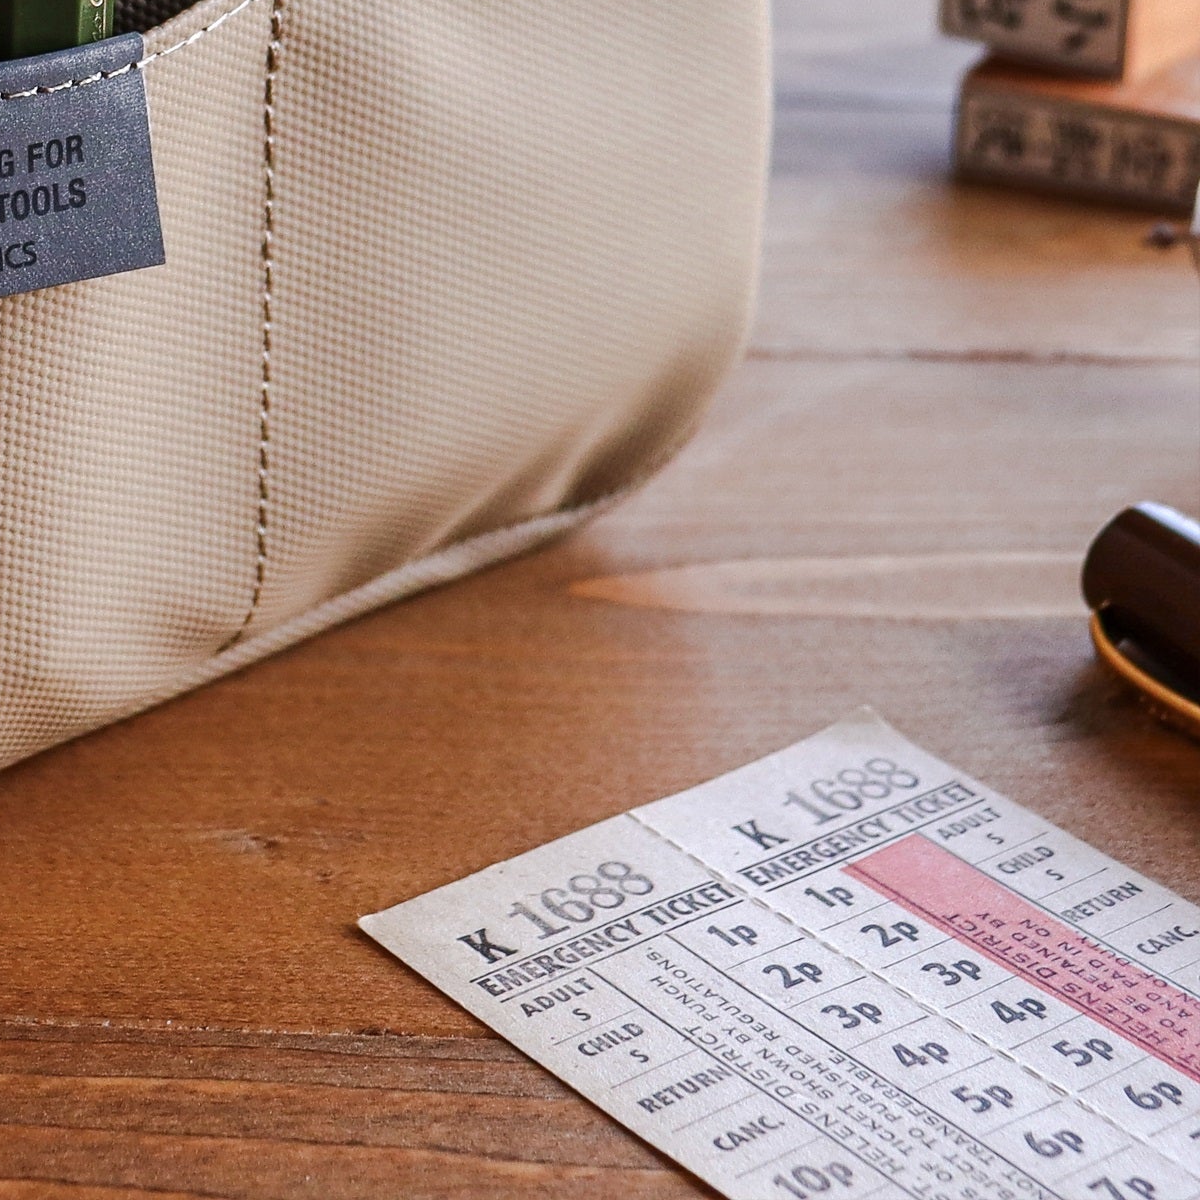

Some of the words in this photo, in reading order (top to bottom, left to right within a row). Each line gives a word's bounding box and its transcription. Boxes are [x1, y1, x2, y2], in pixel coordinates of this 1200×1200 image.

[26, 134, 85, 171] FOR
[732, 819, 790, 850] K
[783, 757, 919, 826] 1688
[742, 817, 892, 887] EMERGENCY
[889, 783, 977, 824] TICKET
[936, 807, 1001, 841] ADULT
[987, 832, 1005, 845] S
[997, 846, 1054, 874] CHILD
[1046, 868, 1065, 881] S
[804, 886, 854, 908] 1p
[1060, 882, 1144, 922] RETURN
[457, 928, 519, 964] K
[507, 861, 654, 940] 1688
[976, 911, 1006, 929] BY
[476, 919, 643, 997] EMERGENCY
[641, 883, 736, 925] TICKET
[707, 924, 758, 947] 1p
[860, 921, 919, 948] 2p
[1018, 918, 1050, 938] ON
[1136, 925, 1199, 956] CANC.
[942, 913, 1058, 980] DISTRICT
[1057, 940, 1083, 956] IN
[762, 961, 823, 989] 2p
[921, 959, 982, 987] 3p
[1011, 932, 1114, 992] RETAINED
[519, 977, 596, 1018] ADULT
[647, 947, 781, 1041] REGULATIONS.
[650, 975, 720, 1022] PUNCH
[1118, 995, 1151, 1014] BE
[1145, 992, 1193, 1019] AND
[572, 1008, 591, 1021] S
[821, 1002, 882, 1029] 3p
[990, 998, 1047, 1024] 4p
[1062, 982, 1168, 1045] HELENS
[578, 1023, 644, 1056] CHILD
[721, 1026, 750, 1045] BY
[1159, 1018, 1188, 1038] TO
[630, 1049, 649, 1063] S
[684, 1026, 795, 1099] DISTRICT
[892, 1041, 949, 1068] 4p
[1052, 1038, 1114, 1067] 5p
[637, 1064, 733, 1113] RETURN
[755, 1048, 834, 1100] SHOWN
[785, 1045, 901, 1123] PUBLISHED
[829, 1049, 994, 1166] TRANSFERABLE.
[952, 1085, 1013, 1113] 5p
[1123, 1082, 1183, 1110] 6p
[713, 1115, 785, 1151] CANC.
[800, 1103, 904, 1174] HELENS
[837, 1104, 913, 1156] TICKET
[908, 1128, 937, 1150] TO
[1023, 1129, 1084, 1158] 6p
[773, 1162, 853, 1199] 10p
[1087, 1176, 1155, 1200] 7p
